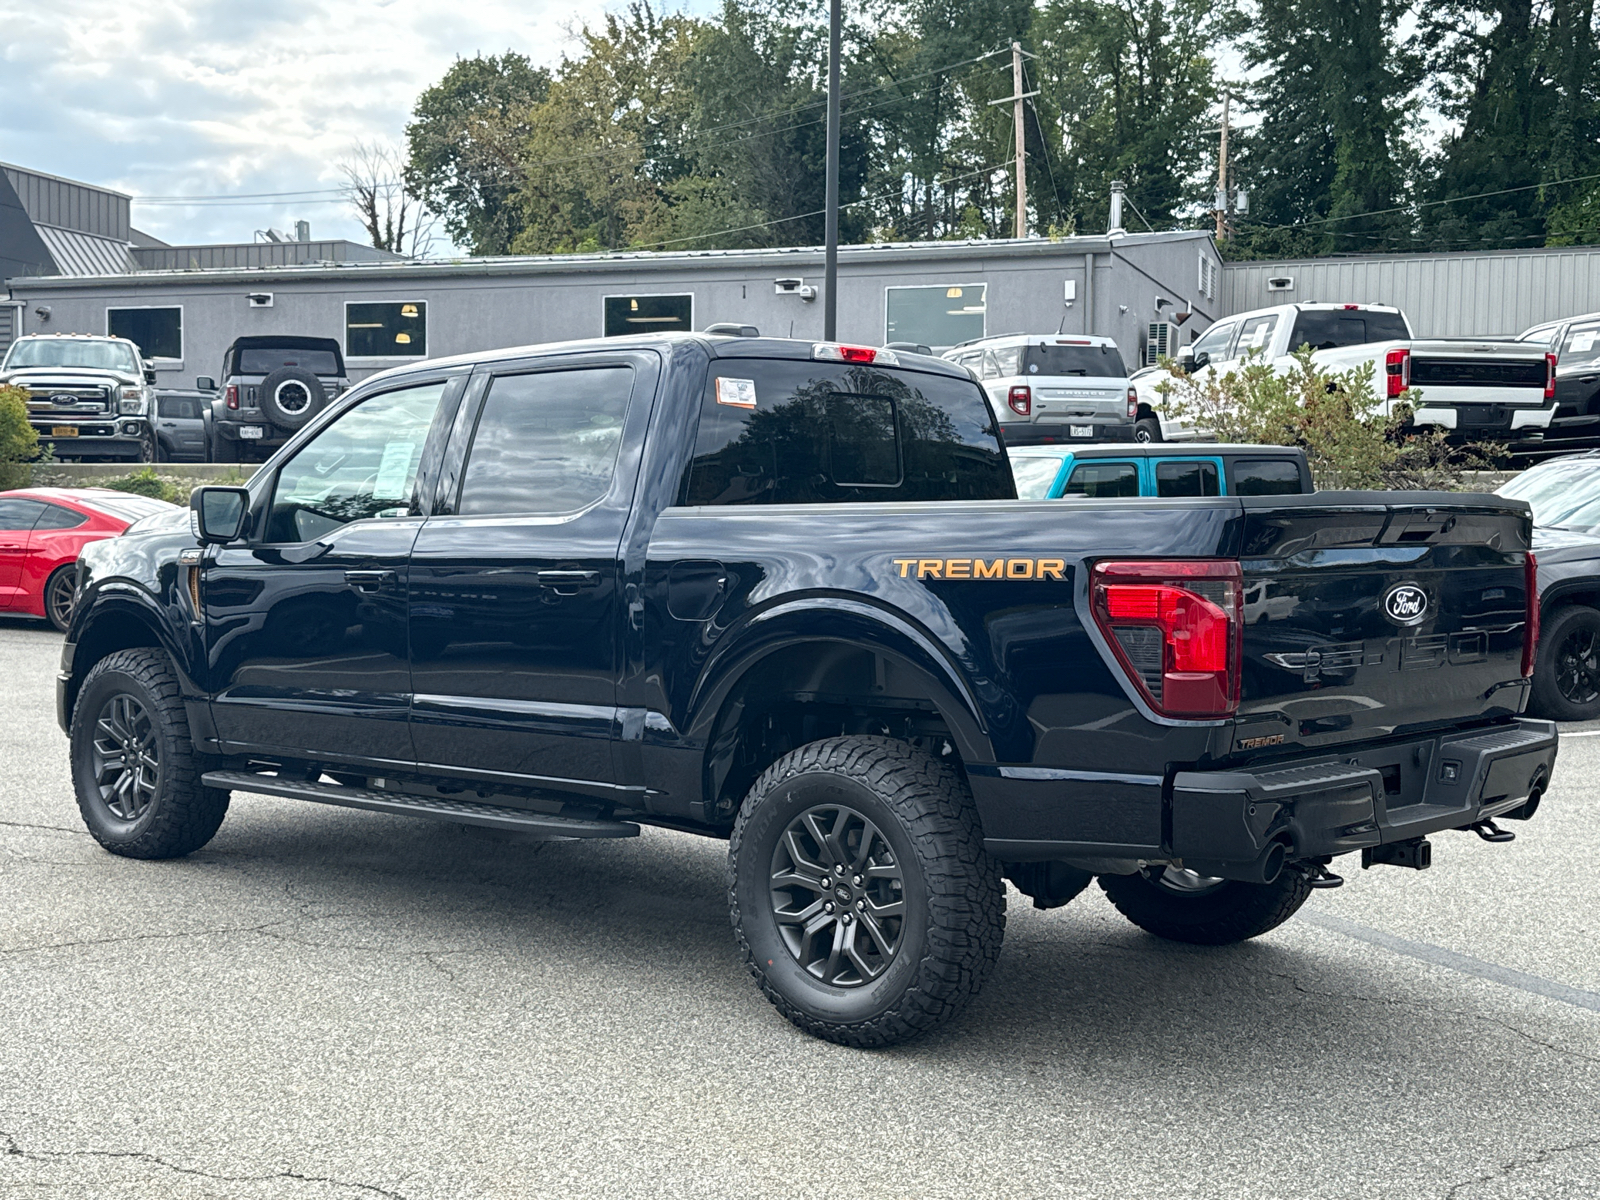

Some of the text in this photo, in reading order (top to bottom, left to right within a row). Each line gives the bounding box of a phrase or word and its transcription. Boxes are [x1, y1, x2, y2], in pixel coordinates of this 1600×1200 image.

[893, 558, 1067, 580] TREMOR
[1393, 590, 1421, 615] Ford
[1303, 629, 1490, 684] F-150
[1240, 734, 1285, 750] TREMOR
